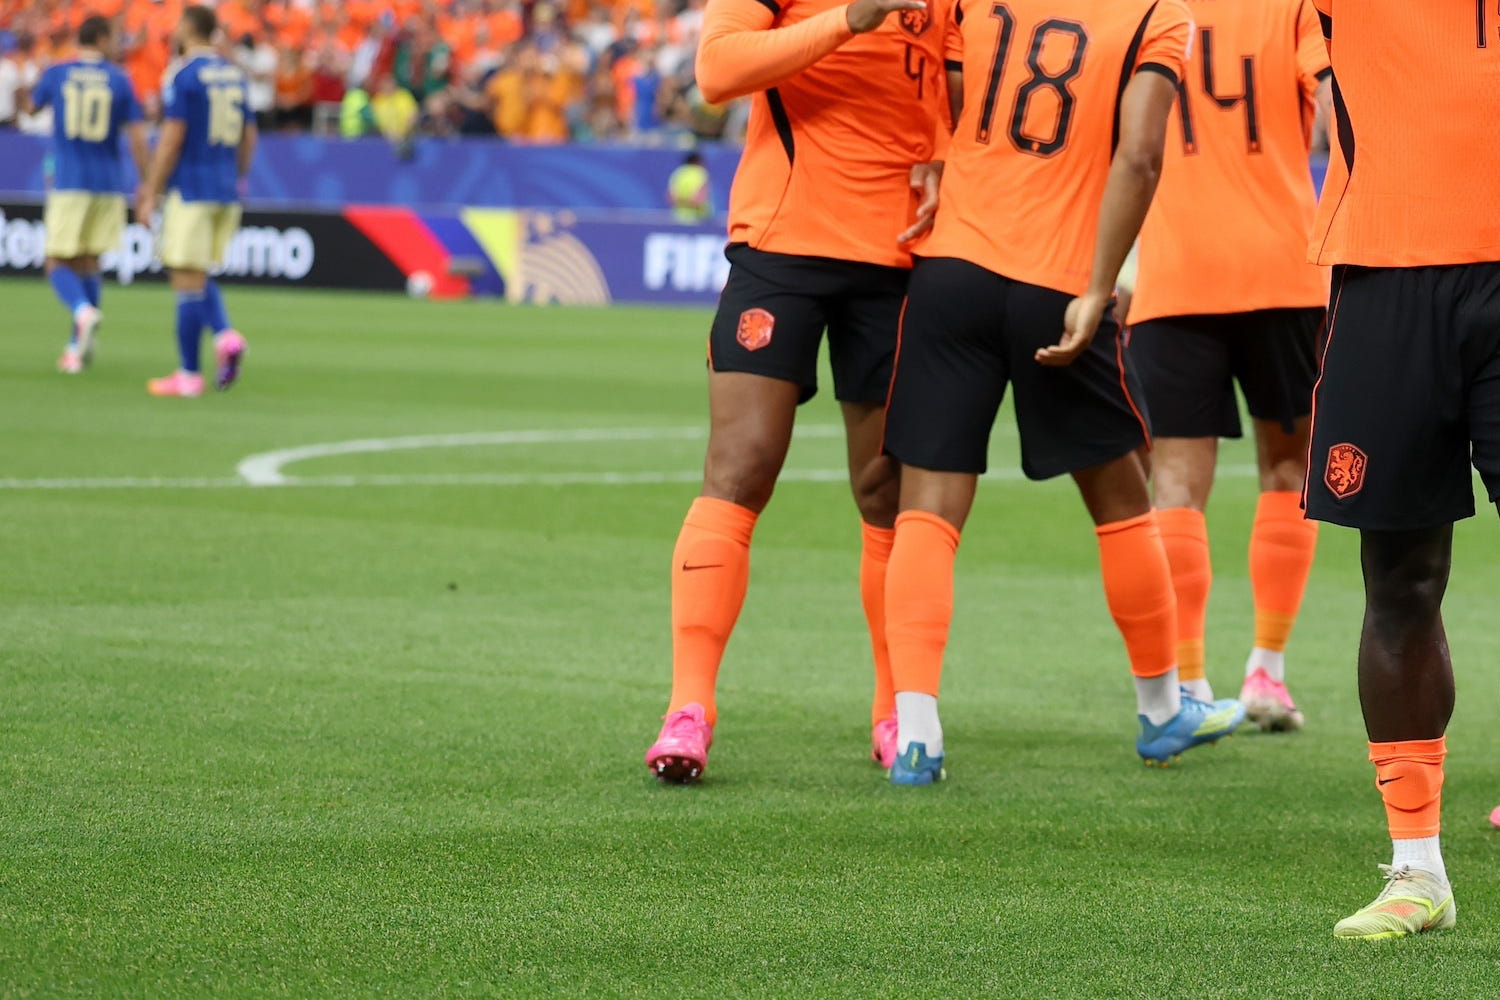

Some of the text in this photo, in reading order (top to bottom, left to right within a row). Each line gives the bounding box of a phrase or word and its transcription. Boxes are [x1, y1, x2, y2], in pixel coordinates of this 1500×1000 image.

[62, 81, 113, 143] 10
[904, 43, 926, 100] 4
[976, 1, 1090, 160] 18
[1177, 26, 1263, 156] 14
